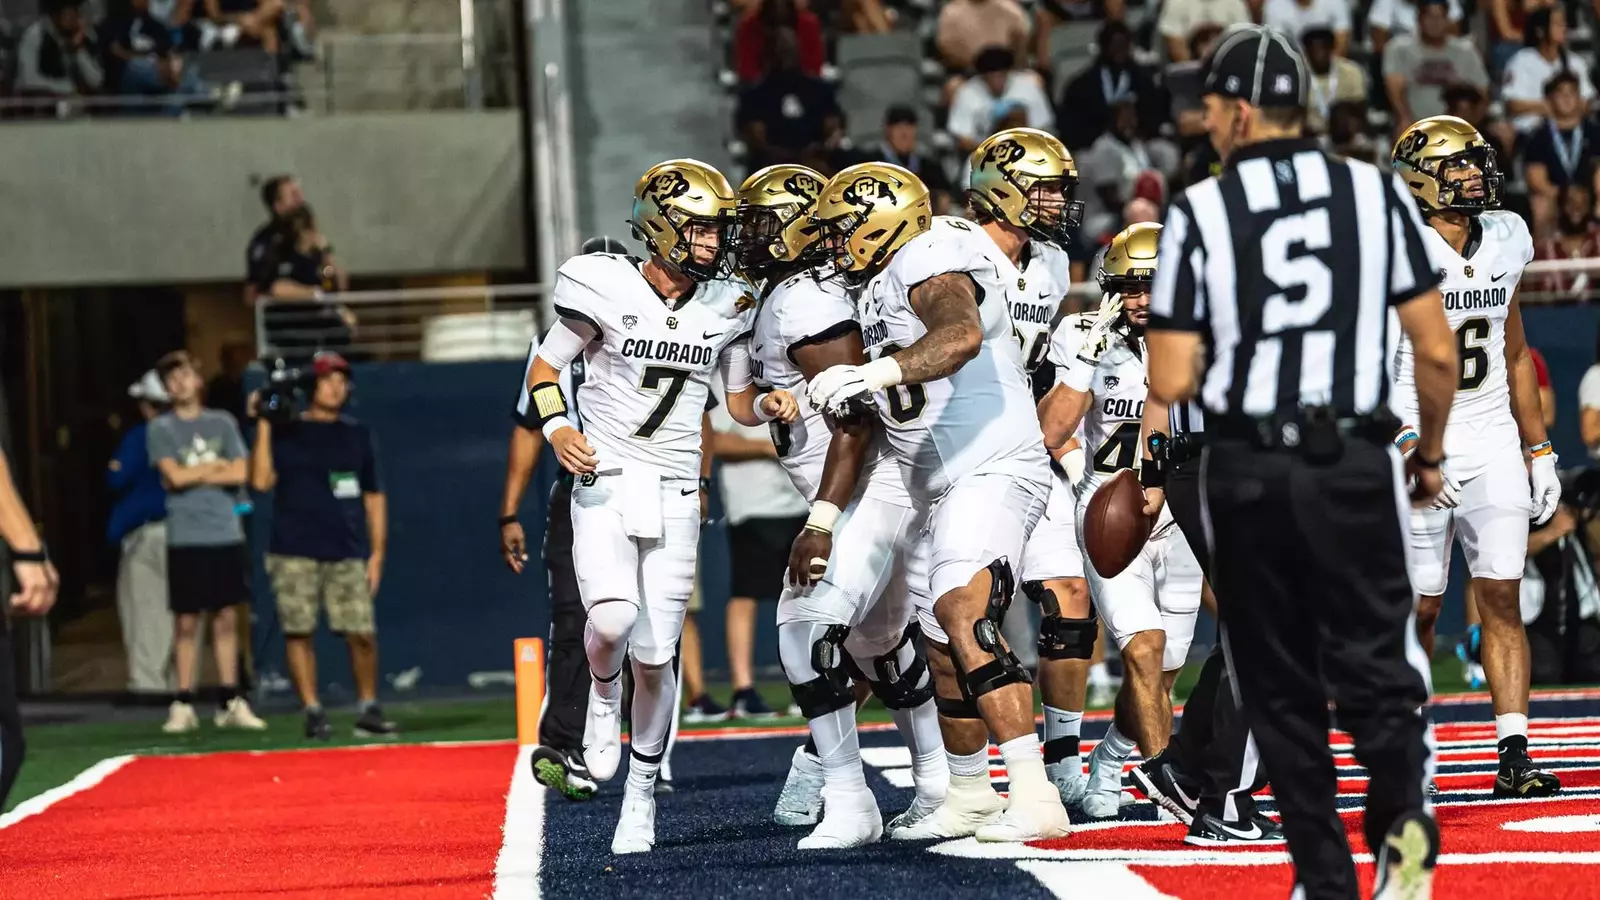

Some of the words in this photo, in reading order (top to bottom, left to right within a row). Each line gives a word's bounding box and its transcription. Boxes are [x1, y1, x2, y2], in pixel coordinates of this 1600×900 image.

[1133, 268, 1151, 276] BUFFS
[1262, 207, 1332, 334] S
[1008, 301, 1050, 324] LORADO
[1441, 287, 1507, 310] OLORADO
[666, 316, 679, 330] CU
[864, 318, 889, 348] ORADO
[621, 338, 713, 366] COLORADO
[1454, 315, 1492, 392] 6
[628, 363, 694, 441] 7
[1102, 398, 1145, 419] COLO
[1093, 421, 1142, 478] 4
